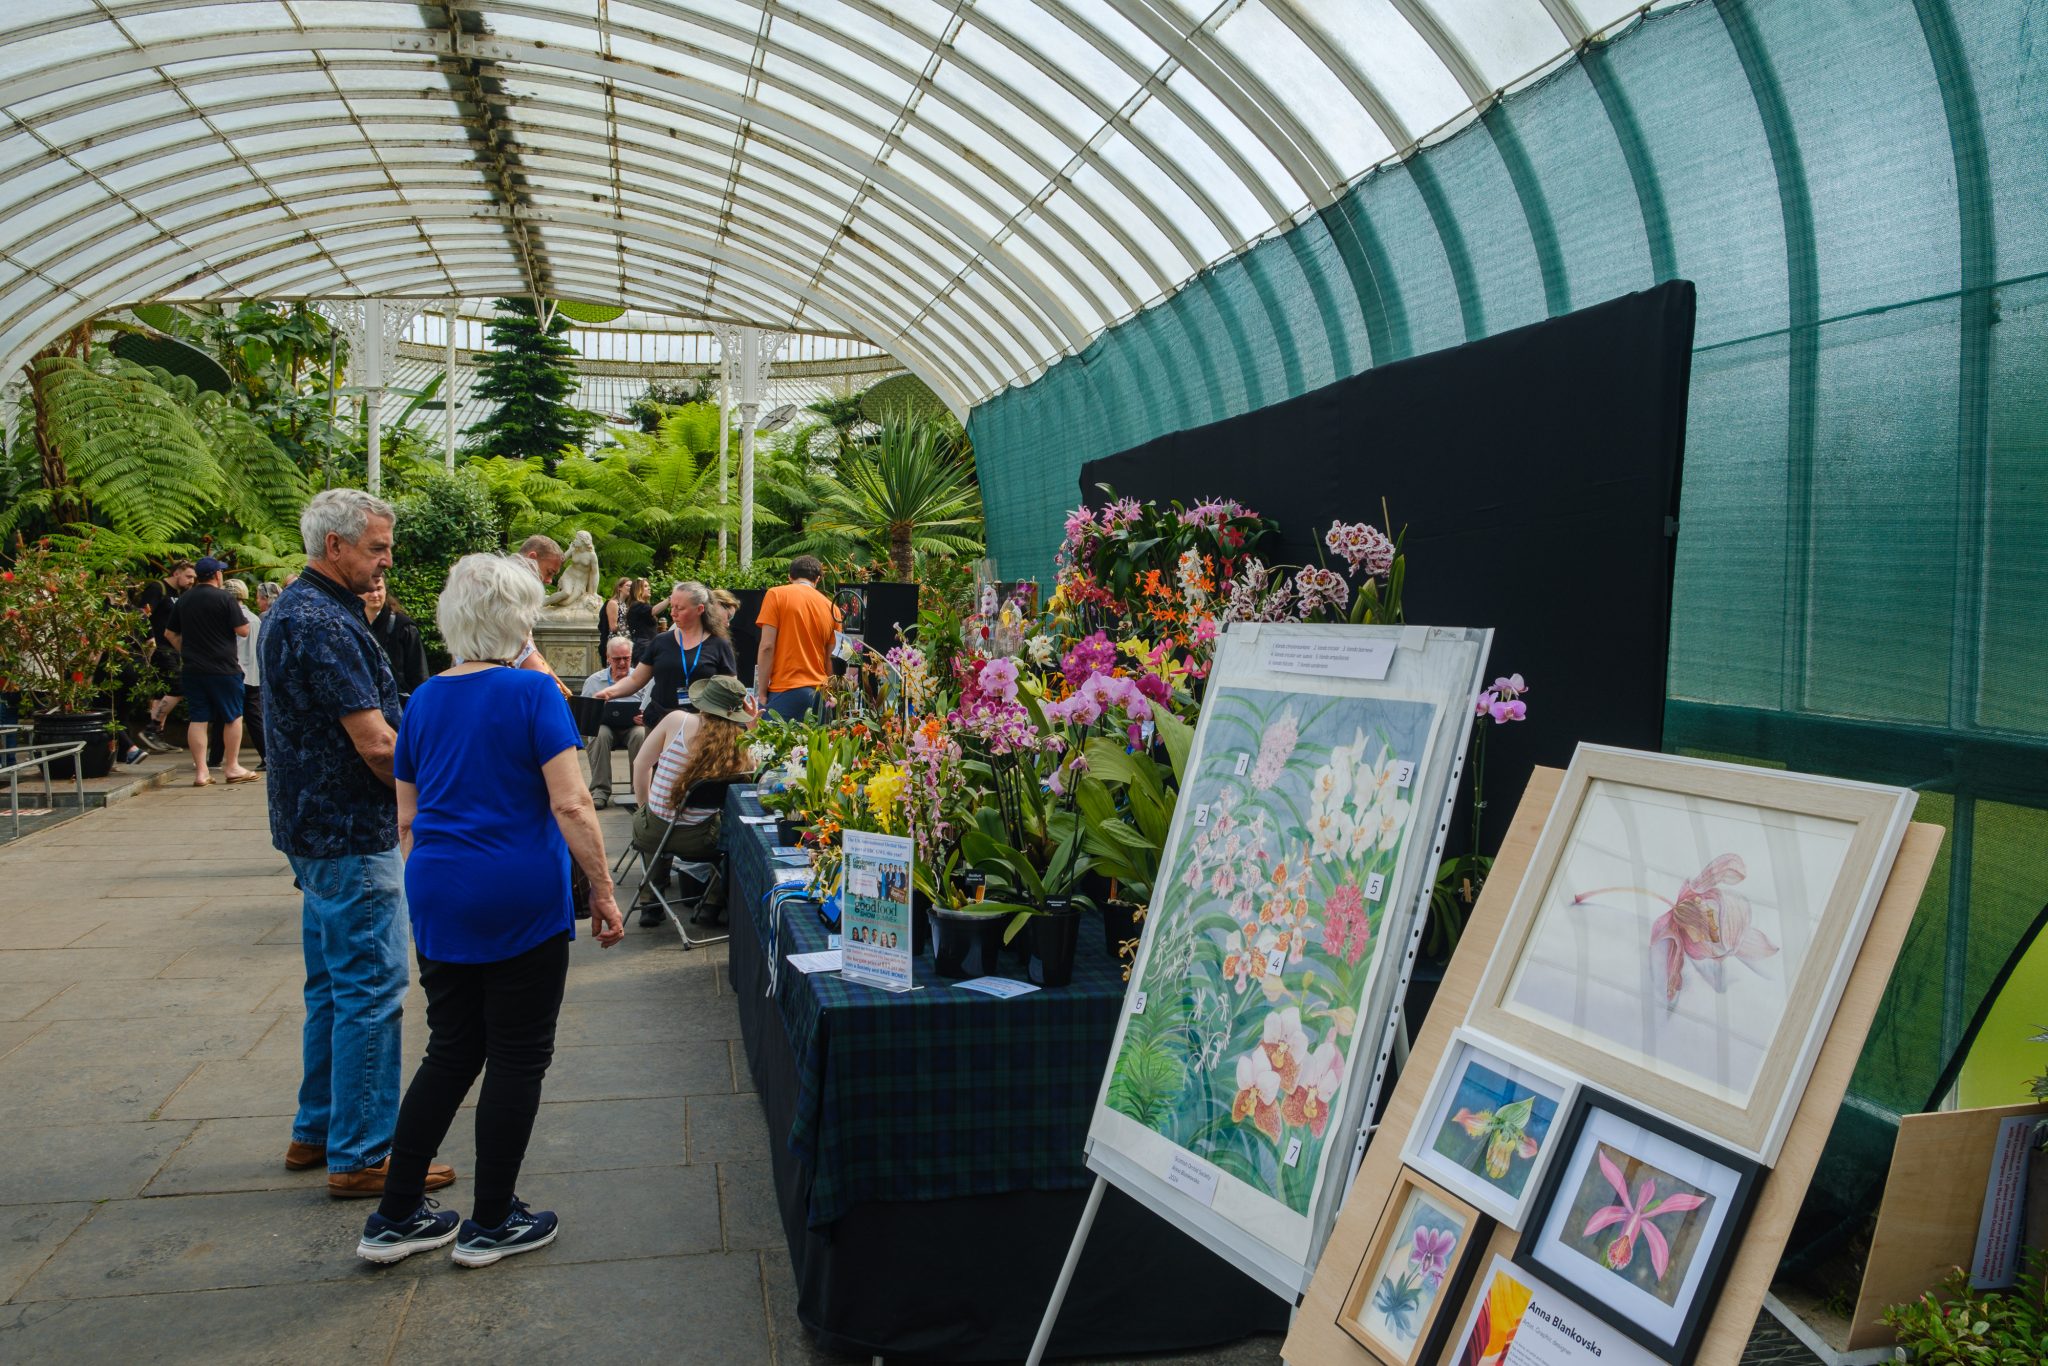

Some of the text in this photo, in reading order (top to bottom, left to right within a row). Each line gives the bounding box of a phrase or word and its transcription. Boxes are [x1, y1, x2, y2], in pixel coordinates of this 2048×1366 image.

[1239, 759, 1245, 771] 1
[1398, 767, 1409, 782] 3
[1198, 810, 1206, 822] 2
[1370, 880, 1380, 895] 5
[1272, 957, 1280, 970] 4
[1136, 997, 1144, 1010] 6
[1290, 1145, 1298, 1160] 7
[1528, 1302, 1551, 1323] Anna
[1551, 1316, 1602, 1357] Blankovska
